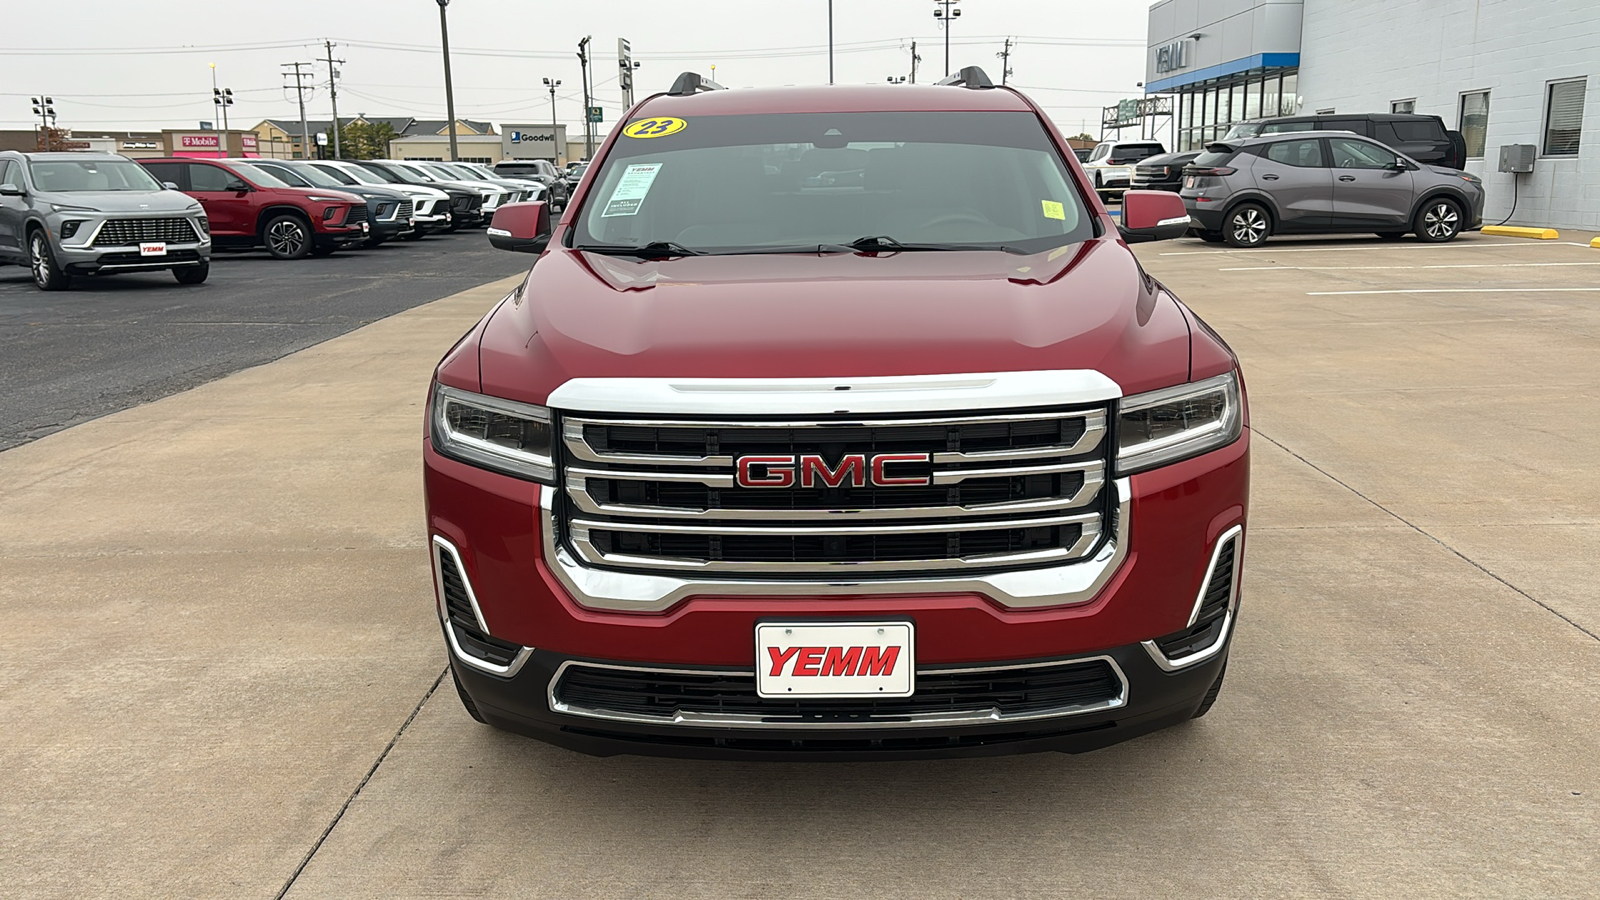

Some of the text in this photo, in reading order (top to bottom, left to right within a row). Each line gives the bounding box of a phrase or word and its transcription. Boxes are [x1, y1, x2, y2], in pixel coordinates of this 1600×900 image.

[521, 133, 555, 141] Goodwill
[633, 119, 674, 135] 23
[736, 452, 930, 488] GMC
[767, 646, 902, 677] YEMM
